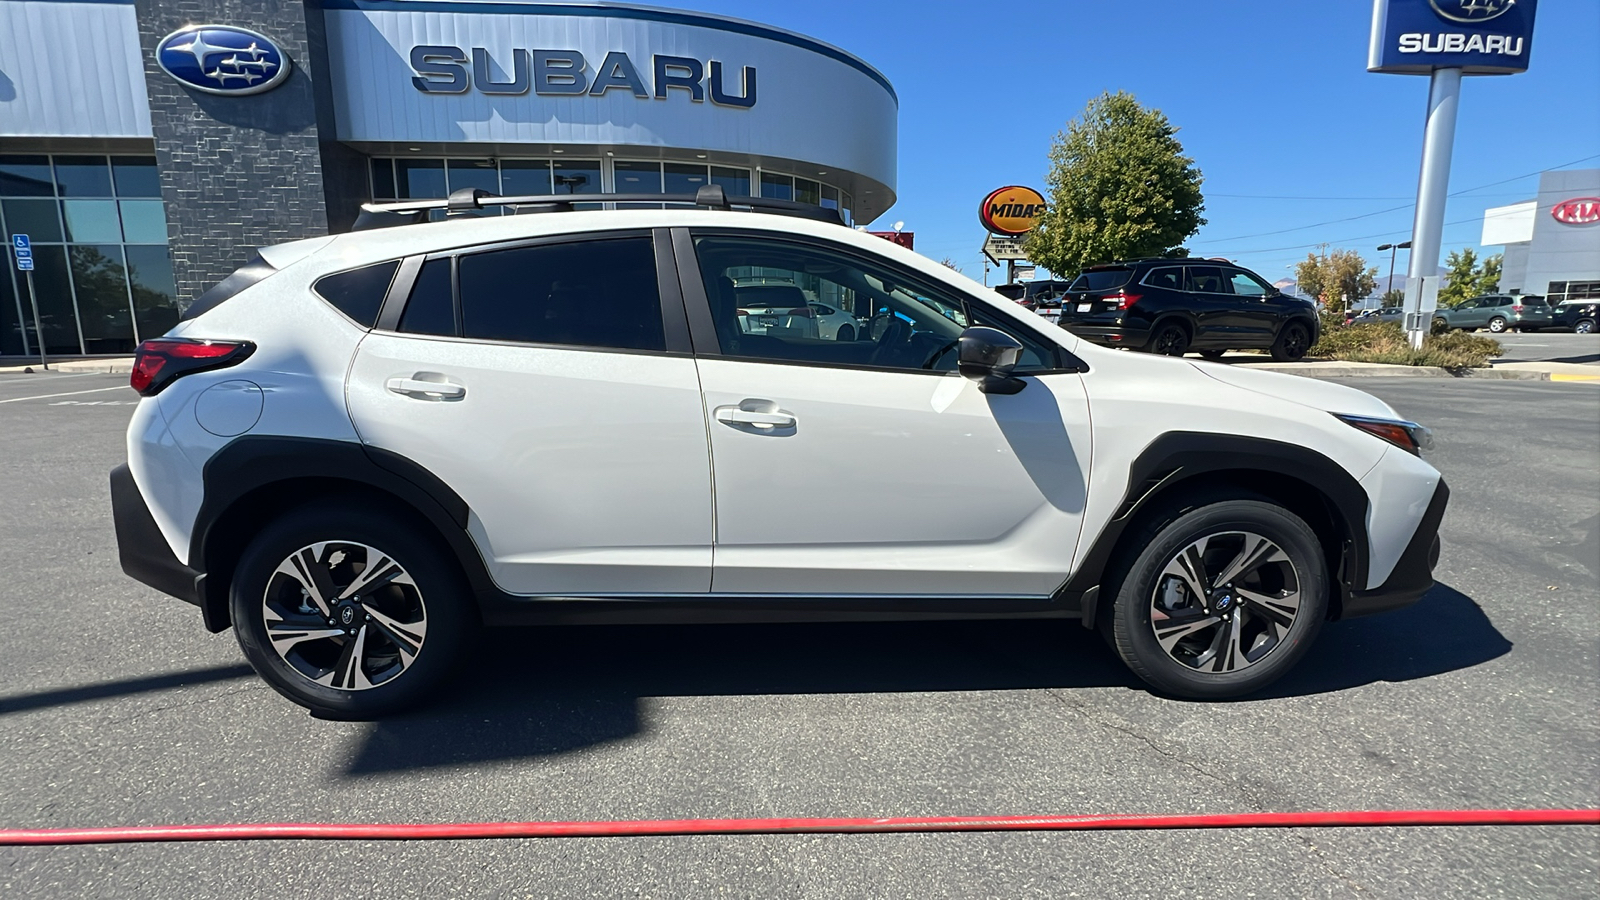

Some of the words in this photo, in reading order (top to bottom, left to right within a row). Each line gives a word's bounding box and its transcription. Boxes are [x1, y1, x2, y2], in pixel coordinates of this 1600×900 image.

[1398, 33, 1523, 56] SUBARU
[410, 45, 757, 109] SUBARU
[1563, 203, 1600, 218] KIA
